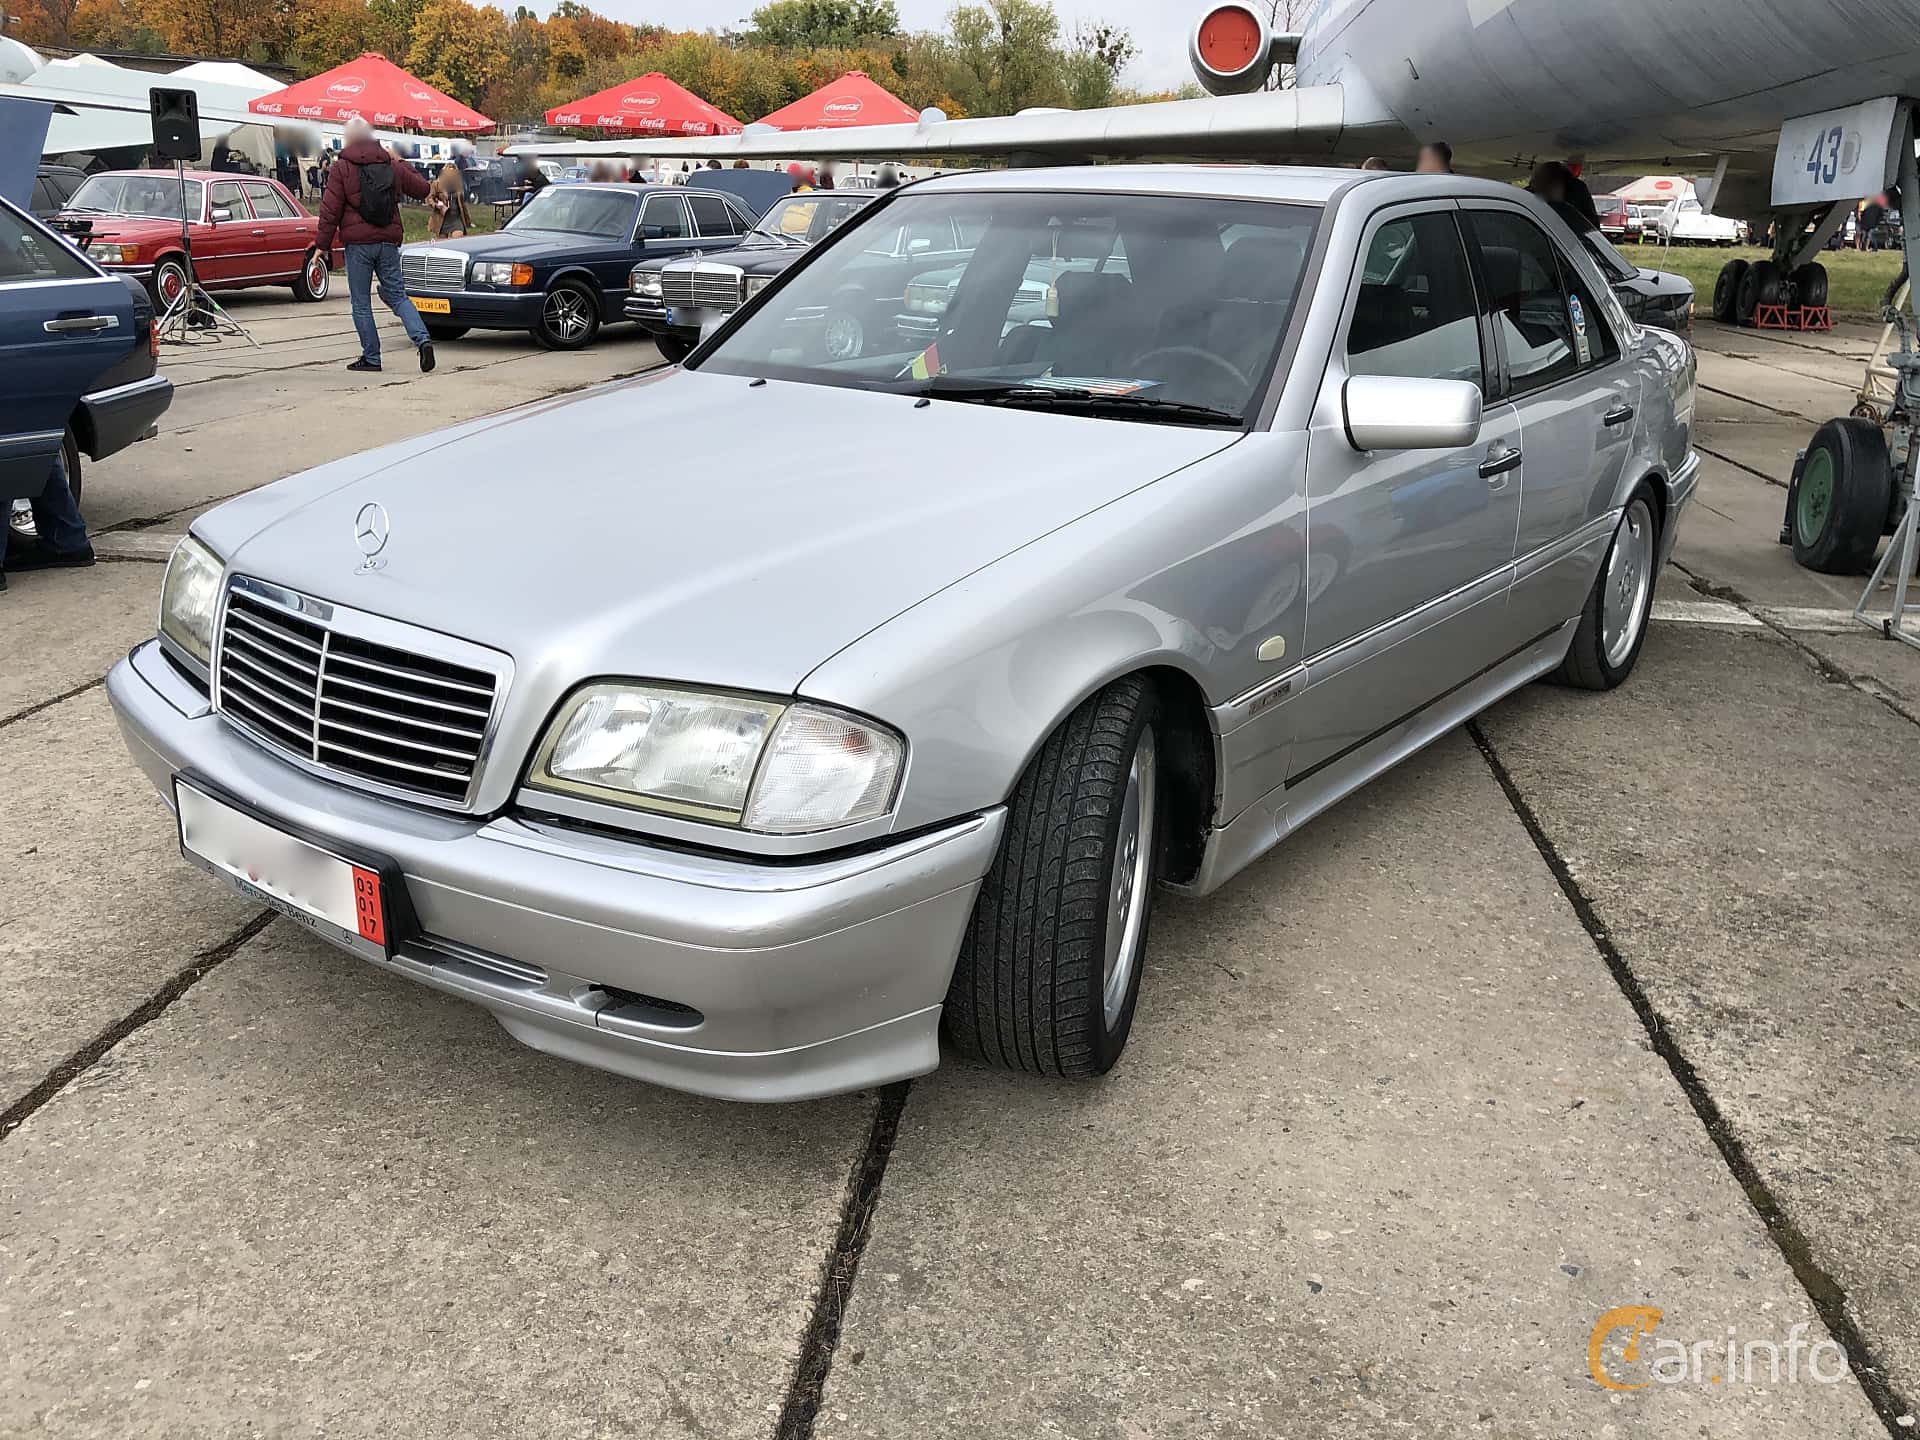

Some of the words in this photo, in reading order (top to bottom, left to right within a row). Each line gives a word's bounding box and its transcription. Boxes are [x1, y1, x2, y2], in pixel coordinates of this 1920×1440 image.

[1807, 126, 1842, 184] 43
[357, 876, 374, 896] 03
[233, 877, 318, 928] Mercedes-Benz
[359, 896, 374, 915] 01
[362, 915, 376, 934] 17
